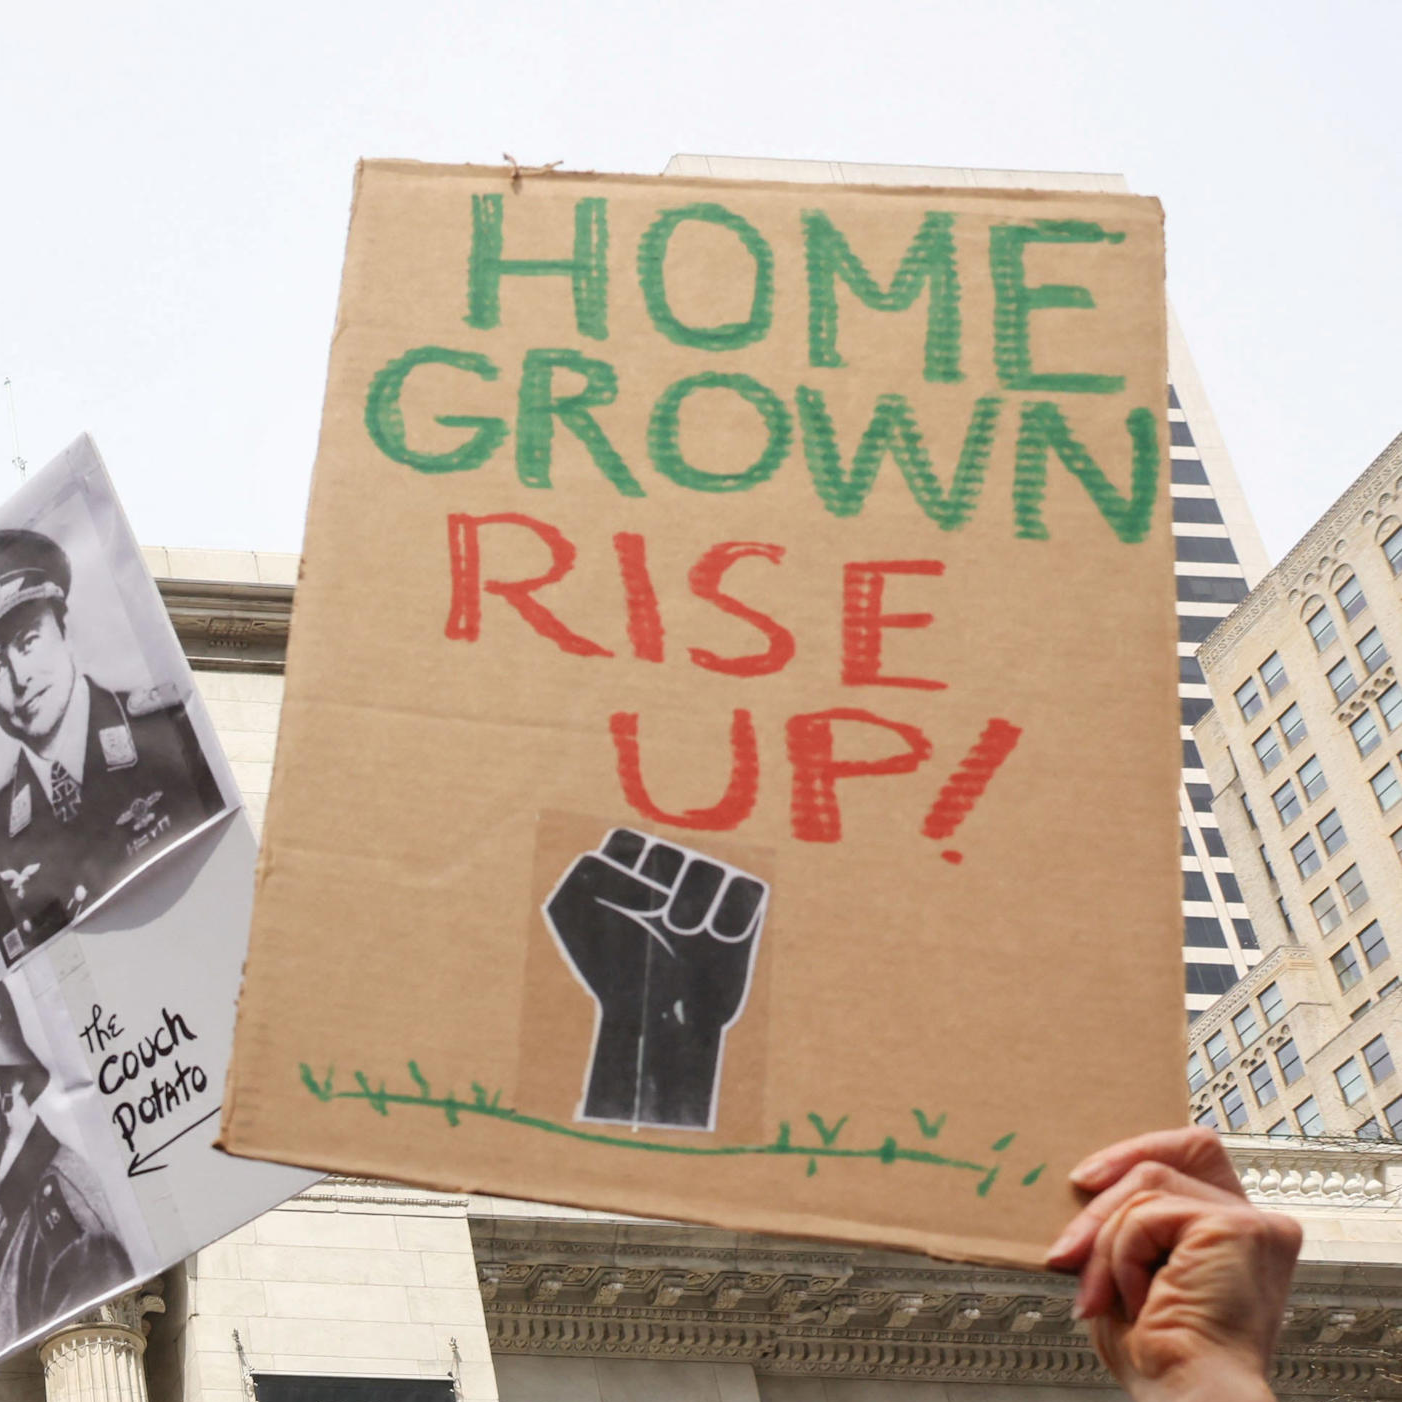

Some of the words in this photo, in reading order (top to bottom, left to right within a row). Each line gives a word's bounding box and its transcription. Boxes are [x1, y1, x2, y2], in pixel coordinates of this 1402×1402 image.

[464, 194, 1127, 392] HOME
[365, 347, 1159, 545] GROWN
[445, 512, 949, 691] RISE
[609, 707, 1023, 865] UP!
